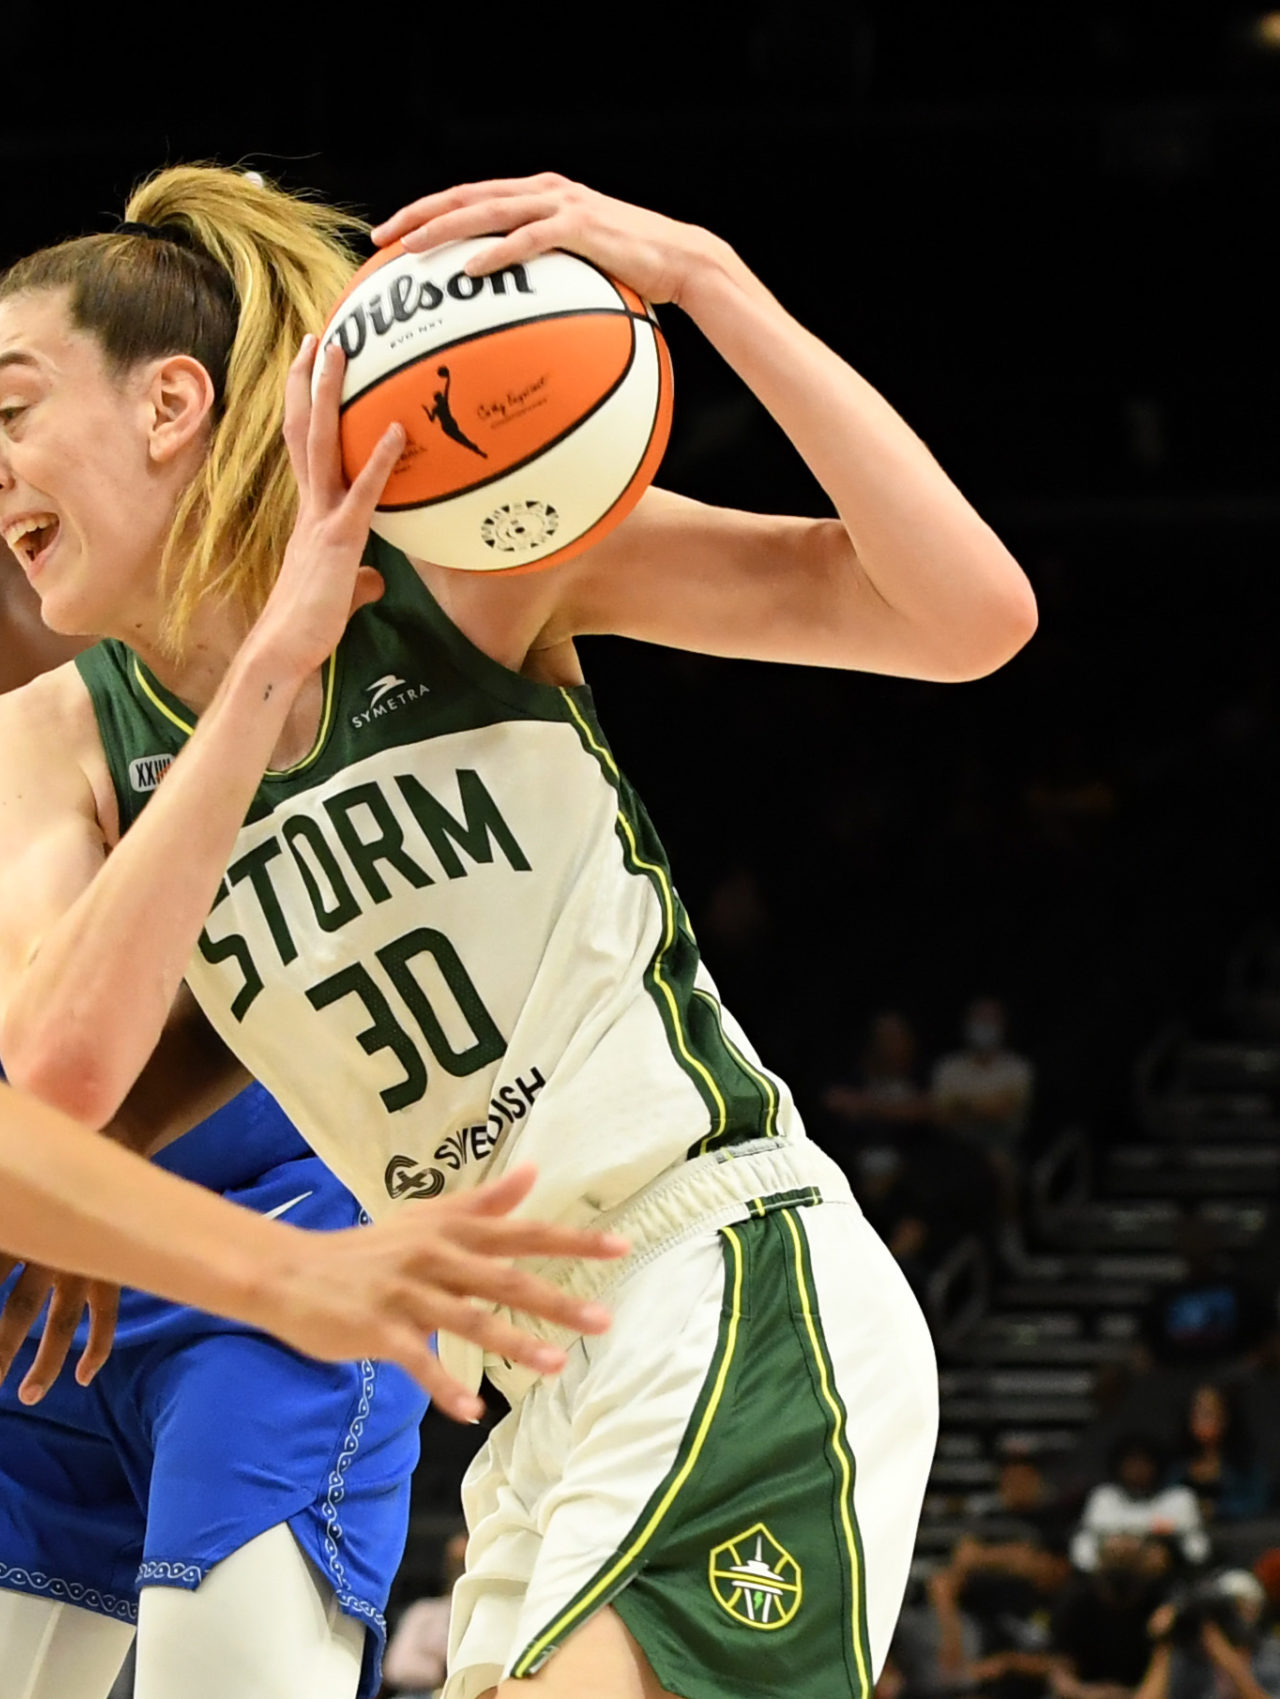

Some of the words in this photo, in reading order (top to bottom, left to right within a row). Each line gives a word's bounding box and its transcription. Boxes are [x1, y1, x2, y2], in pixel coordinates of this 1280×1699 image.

[325, 262, 535, 360] Wilson
[351, 683, 431, 729] SYMETRA
[197, 768, 534, 1025] STORM
[304, 926, 509, 1114] 30
[433, 1066, 547, 1171] SWEDISH
